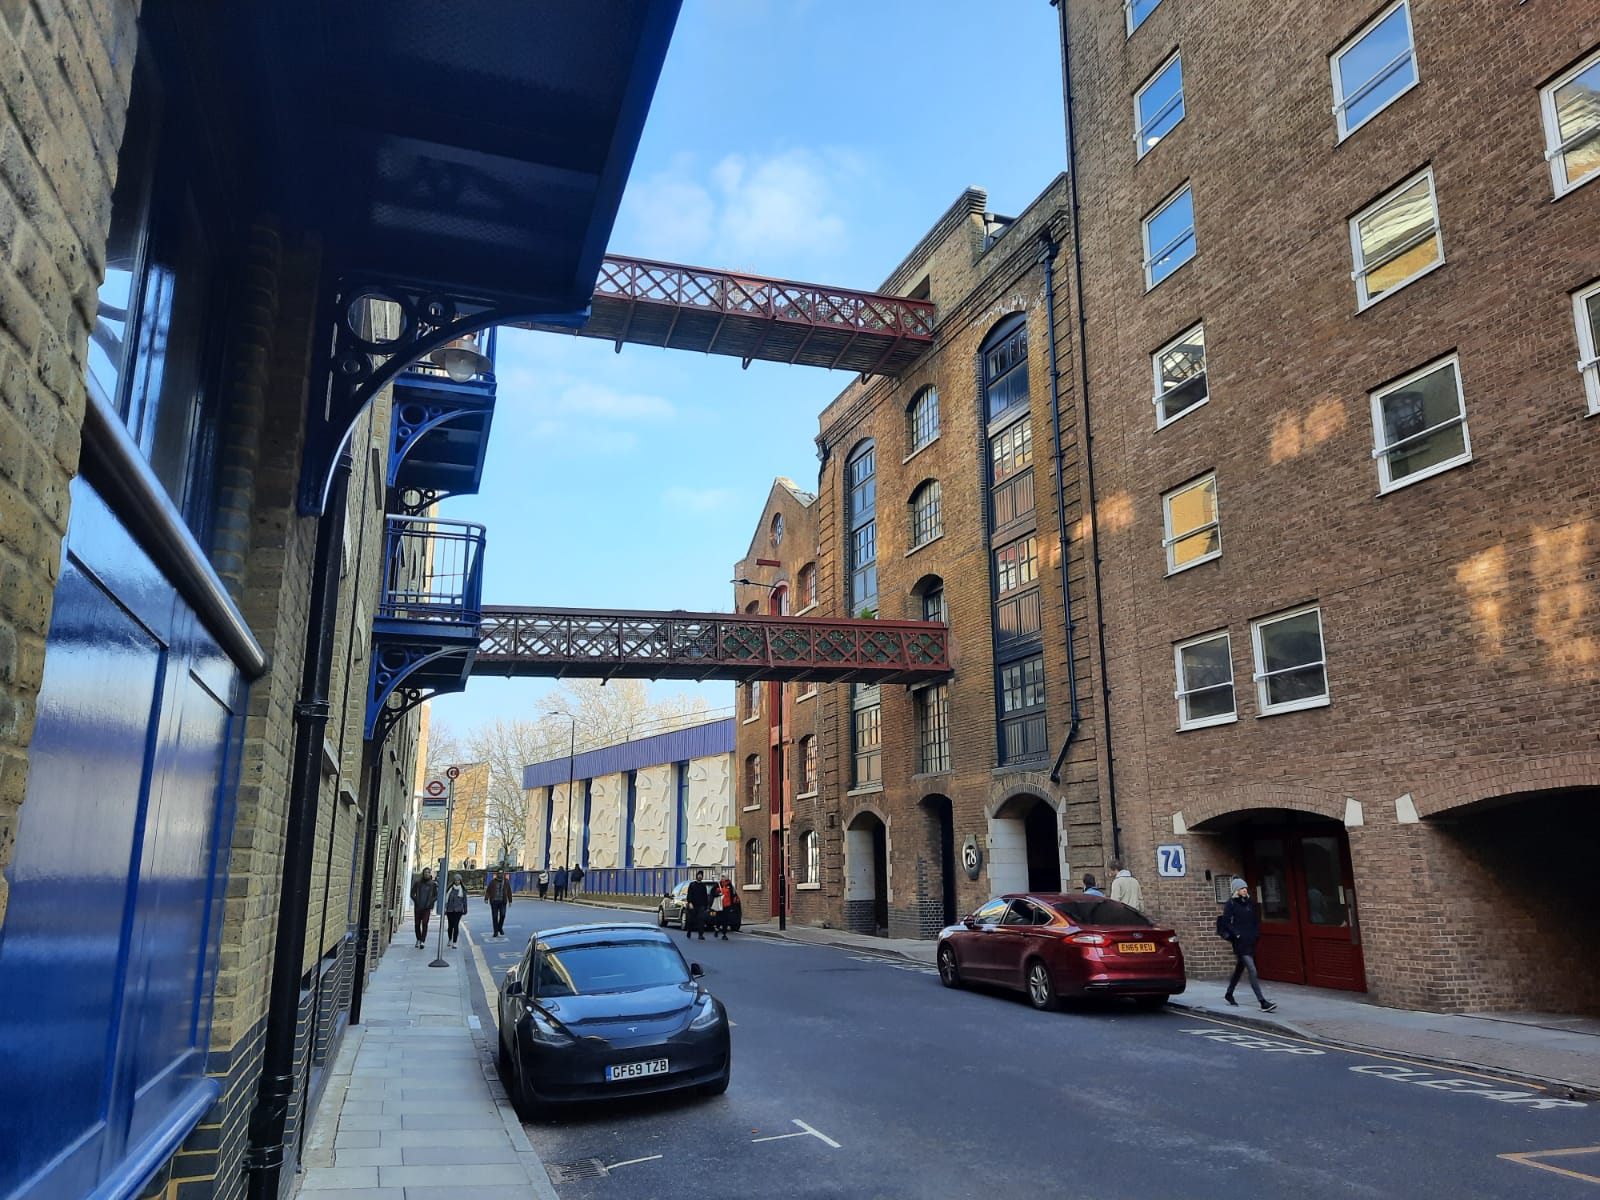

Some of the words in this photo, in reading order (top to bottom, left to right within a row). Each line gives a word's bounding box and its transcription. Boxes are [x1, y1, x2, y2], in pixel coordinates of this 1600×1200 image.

[966, 849, 976, 864] 78
[1160, 850, 1182, 872] 74
[1178, 1029, 1326, 1056] KEEP
[613, 1064, 642, 1078] GF69
[645, 1060, 667, 1073] TZB
[1348, 1065, 1588, 1110] CLEAR
